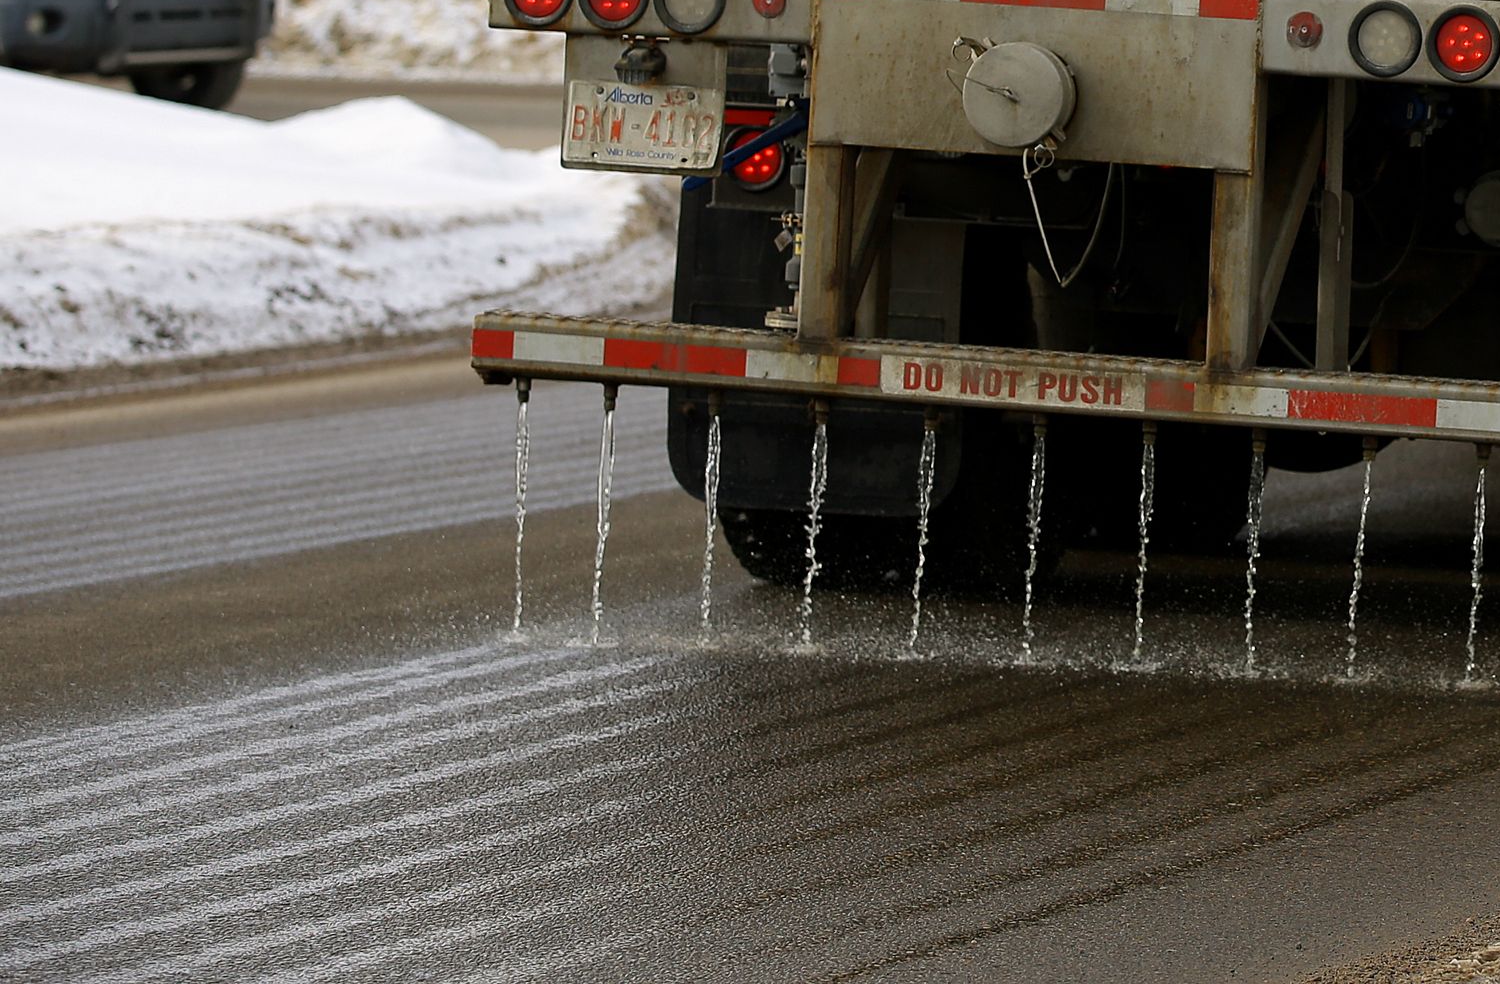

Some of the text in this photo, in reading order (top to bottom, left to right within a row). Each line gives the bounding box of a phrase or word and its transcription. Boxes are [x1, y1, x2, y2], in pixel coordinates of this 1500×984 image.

[605, 86, 653, 105] Alberta
[606, 147, 624, 157] Wild
[648, 150, 677, 161] County
[903, 362, 1123, 405] DO NOT PUSH
